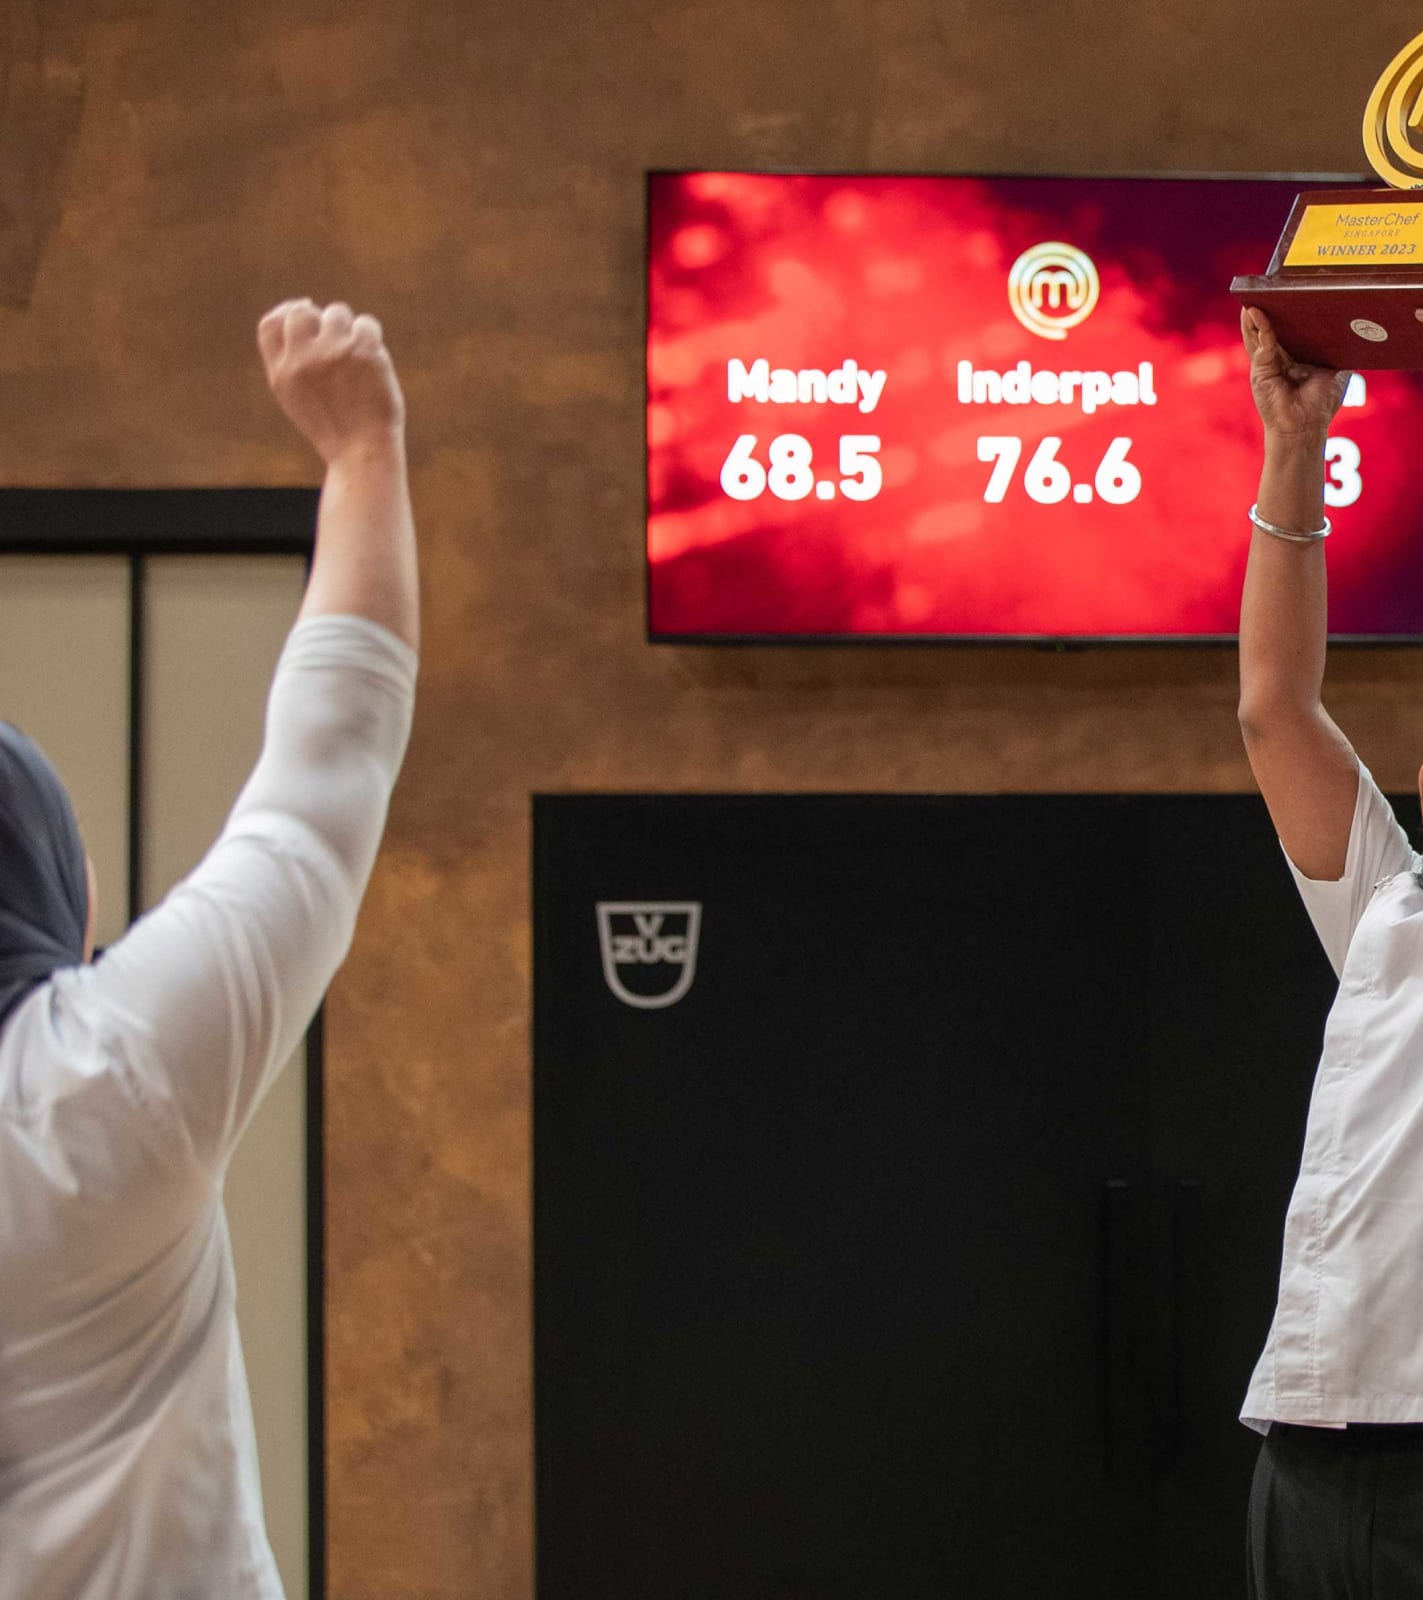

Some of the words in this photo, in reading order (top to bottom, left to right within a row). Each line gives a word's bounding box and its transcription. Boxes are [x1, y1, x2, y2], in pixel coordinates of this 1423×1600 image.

[1335, 212, 1421, 227] MasterChef
[1343, 229, 1401, 238] SINGAPORE
[1316, 245, 1377, 257] WINNER
[1380, 243, 1417, 255] 2023
[727, 358, 887, 414] Mandy
[957, 359, 1157, 414] Inderpal
[720, 433, 883, 501] 68.5
[976, 436, 1142, 505] 76.6
[632, 913, 666, 939] V
[613, 934, 687, 965] ZUG
